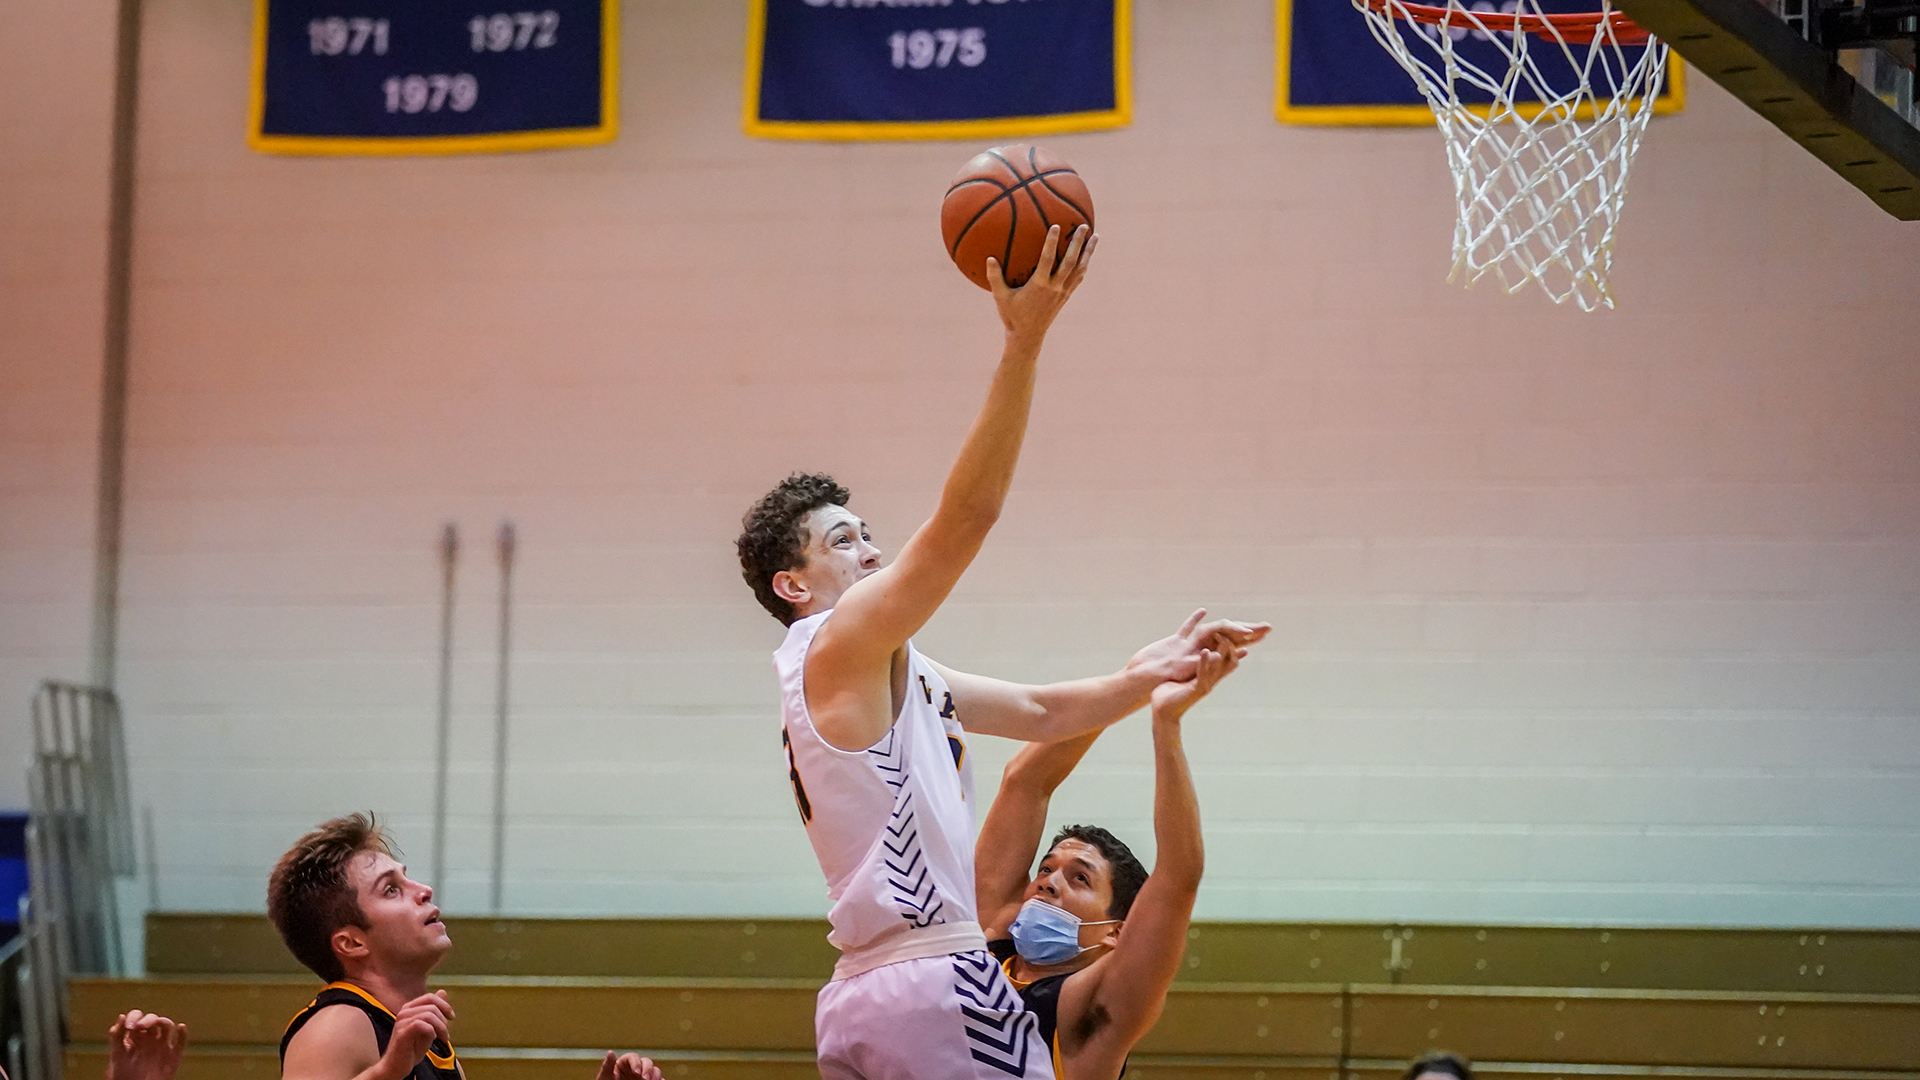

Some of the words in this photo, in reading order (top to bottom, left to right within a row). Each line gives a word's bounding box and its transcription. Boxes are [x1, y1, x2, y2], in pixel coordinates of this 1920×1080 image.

[309, 17, 389, 55] 1971
[470, 11, 559, 51] 1972
[888, 28, 987, 68] 1975
[384, 73, 478, 113] 1979
